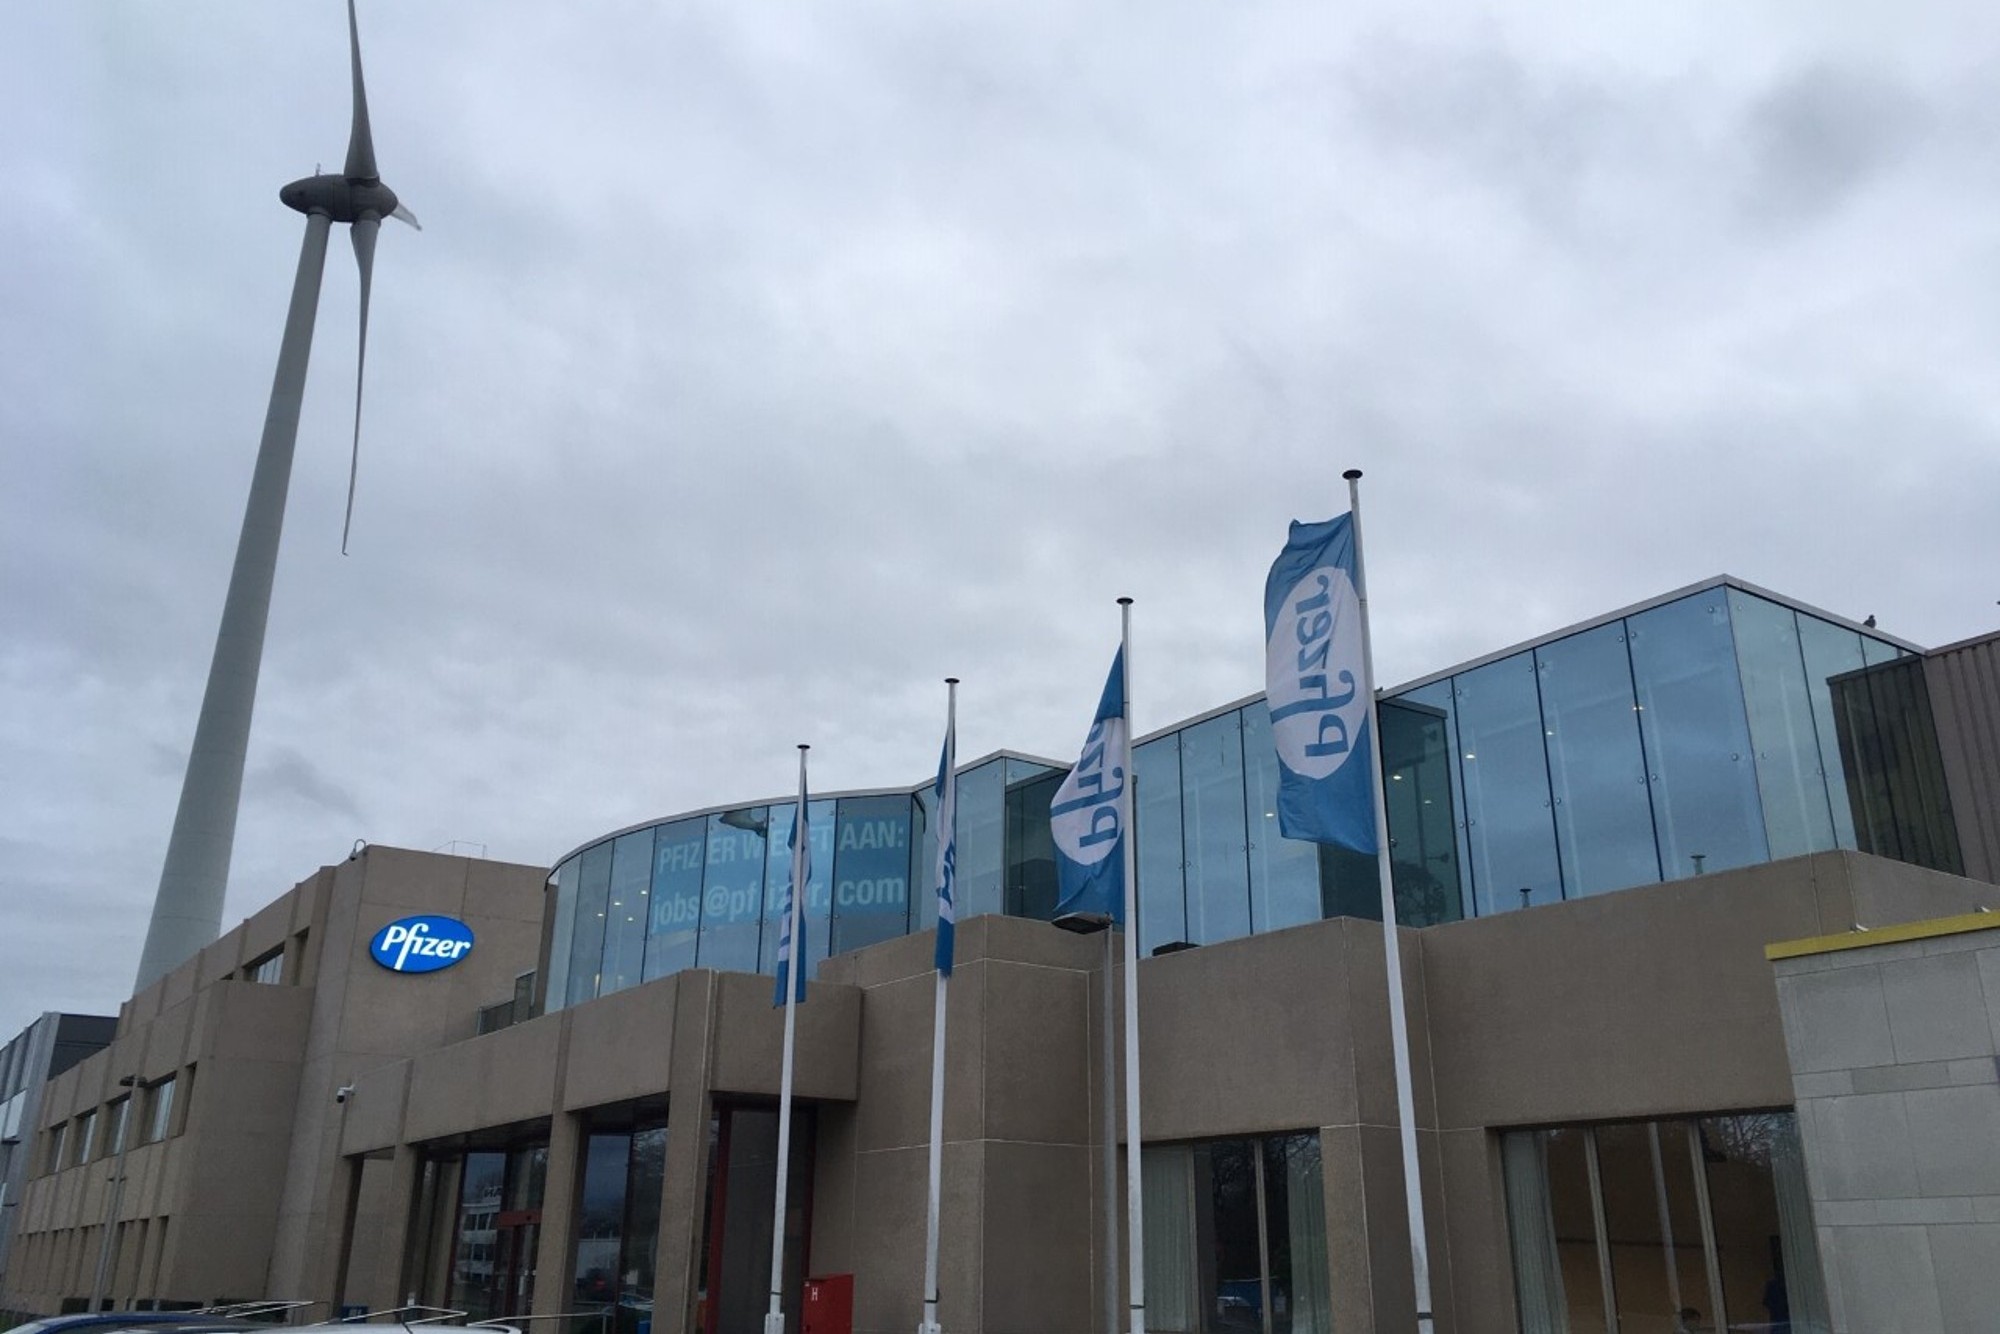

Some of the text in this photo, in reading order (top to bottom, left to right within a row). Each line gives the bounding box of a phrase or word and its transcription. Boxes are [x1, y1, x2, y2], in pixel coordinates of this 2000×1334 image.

[743, 824, 833, 860] WET
[839, 821, 904, 851] AAN:
[652, 877, 905, 933] jobs@pfizr.com
[380, 923, 471, 970] Pfizer
[811, 1287, 818, 1301] H
